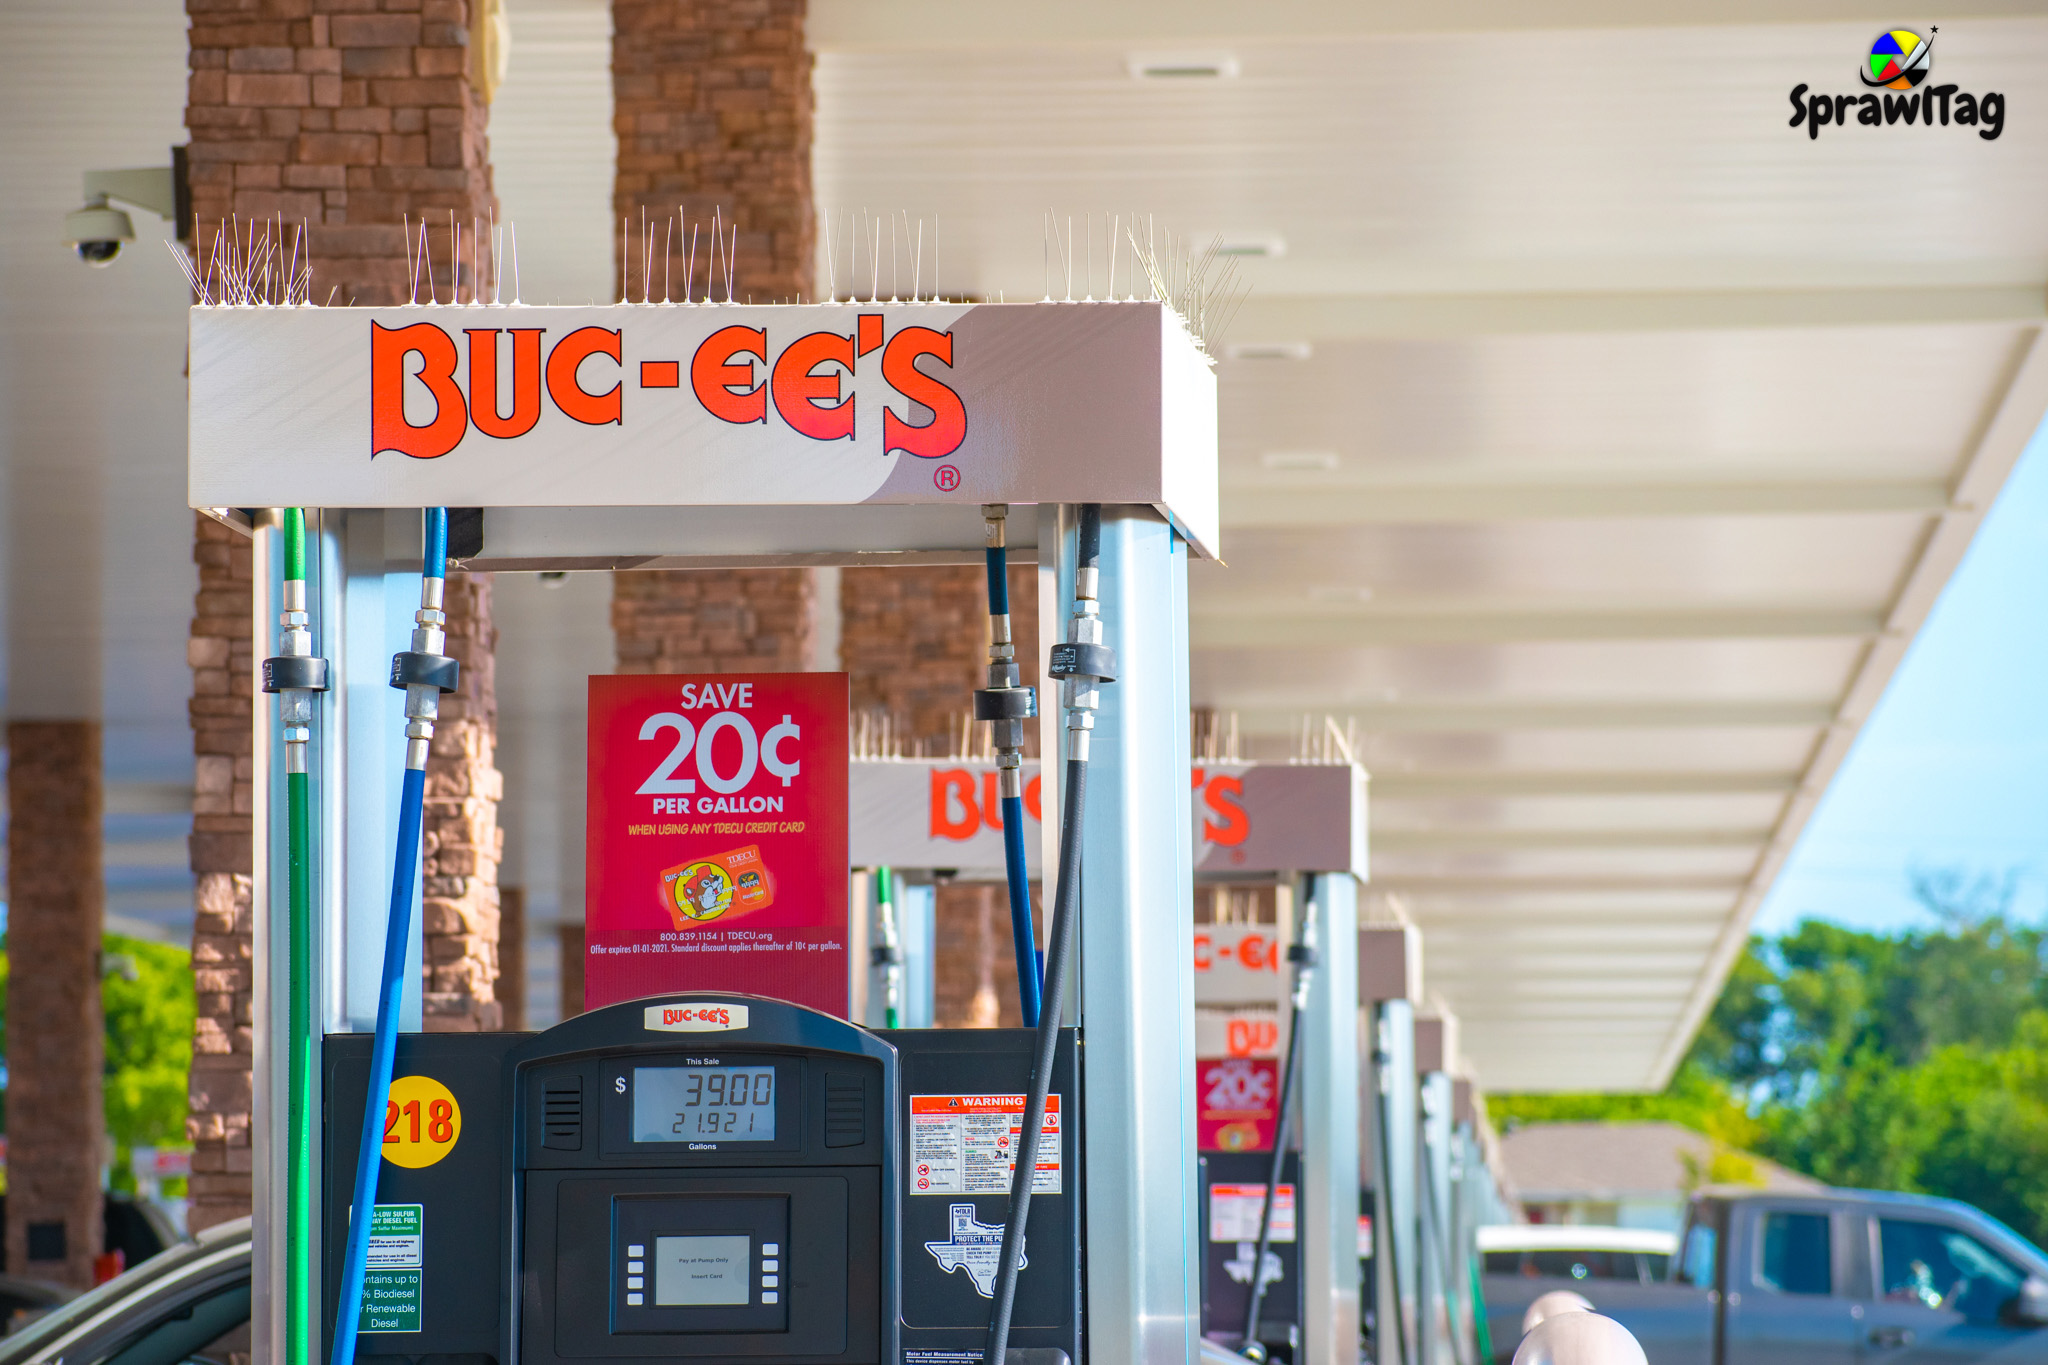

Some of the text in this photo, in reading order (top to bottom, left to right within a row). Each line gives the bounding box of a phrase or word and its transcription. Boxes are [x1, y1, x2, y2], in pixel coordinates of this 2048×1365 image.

[371, 314, 968, 461] BUC-EE'S
[681, 683, 753, 709] SAVE
[634, 711, 800, 794] 20¢
[653, 796, 783, 814] PER GALLON
[628, 821, 805, 835] WHEN USING ANY TDECU CREDIT CARD
[727, 850, 757, 864] TDECU
[660, 931, 717, 941] 800.839.1154
[727, 930, 773, 941] TDECU.org
[590, 944, 607, 954] Offer
[608, 944, 631, 955] expires
[632, 943, 670, 953] 01-01-2021.
[671, 942, 700, 952] Standard
[701, 941, 727, 952] discount
[728, 941, 752, 953] applies
[753, 941, 784, 951] thereafter
[786, 940, 794, 950] of
[808, 942, 819, 952] per
[820, 940, 843, 952] gallon.
[663, 1008, 730, 1025] BUC-EE'S
[615, 1076, 627, 1095] $
[685, 1073, 772, 1107] 39.00
[962, 1097, 1024, 1107] WARNING
[382, 1098, 453, 1143] 218
[672, 1112, 754, 1134] 21.921
[395, 1276, 406, 1285] up
[409, 1275, 418, 1283] to
[374, 1289, 415, 1298] Biodiesel
[366, 1304, 416, 1313] Renewable
[371, 1318, 399, 1328] Diesel
